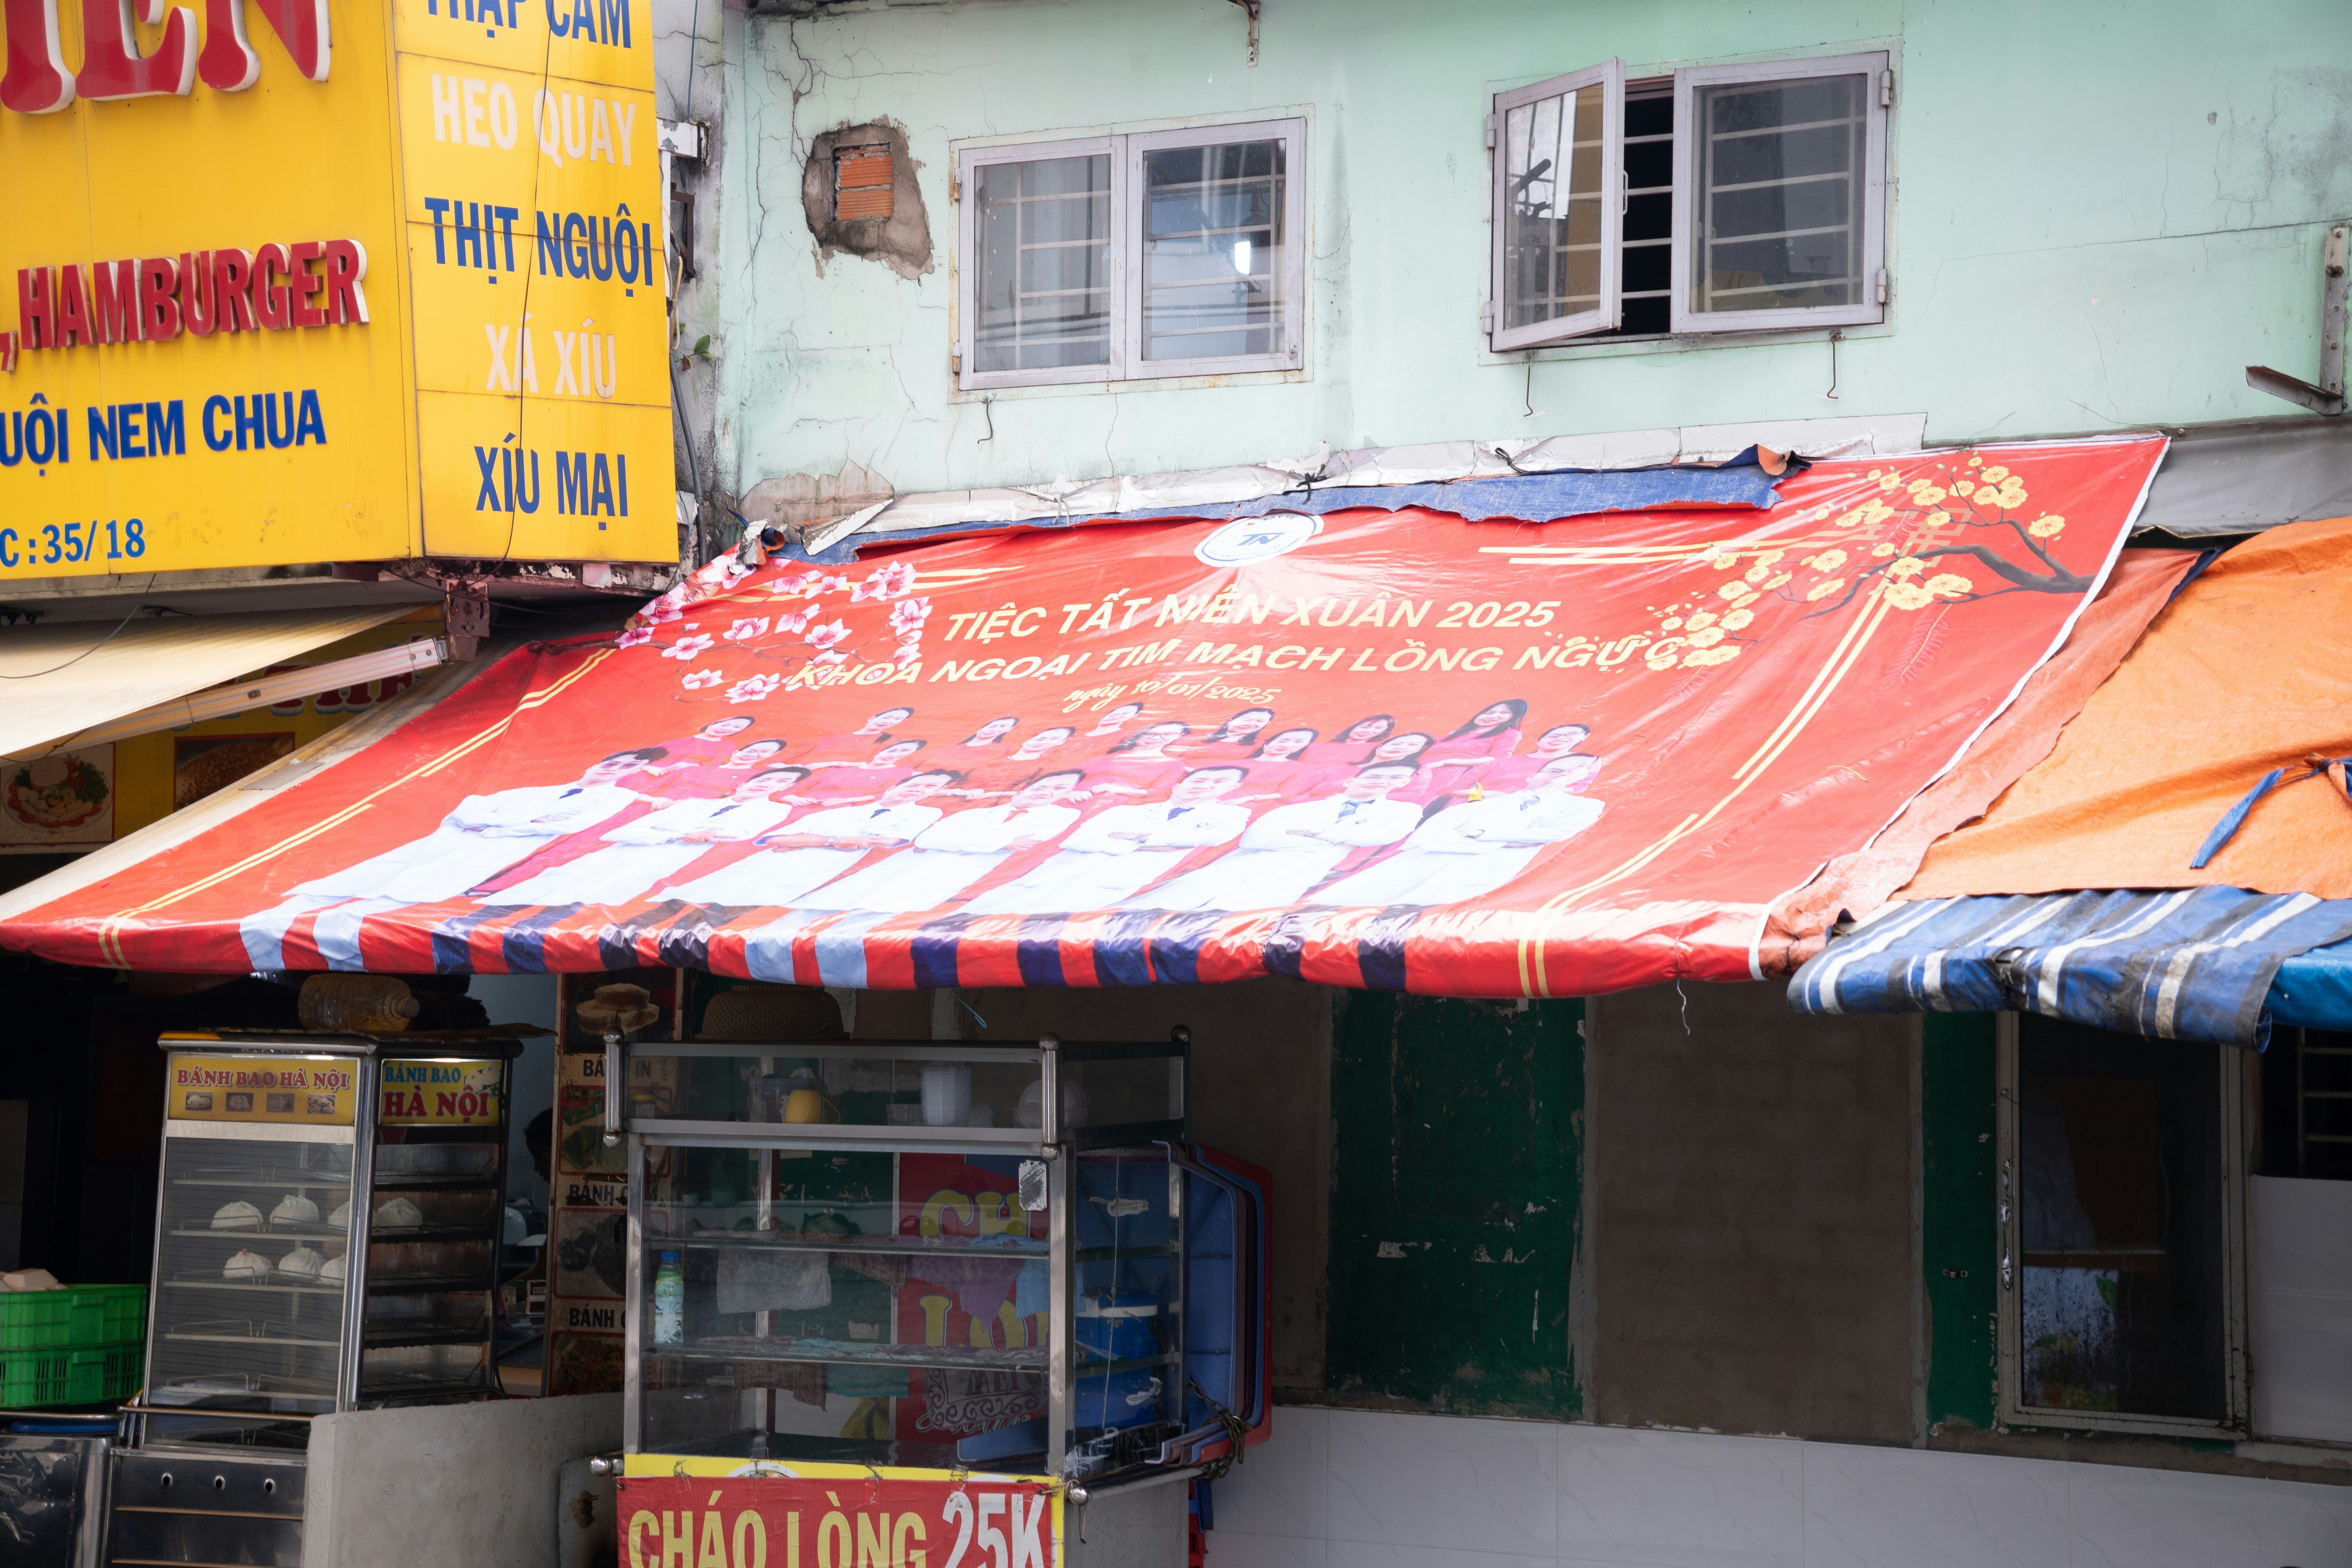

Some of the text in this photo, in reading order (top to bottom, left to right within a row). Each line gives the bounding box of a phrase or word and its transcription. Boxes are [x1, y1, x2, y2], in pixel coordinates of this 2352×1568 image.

[431, 73, 636, 169] HEO QUAY
[425, 197, 653, 298] THỊT NGUỘI
[485, 312, 617, 399] XÁ XÍU
[87, 399, 186, 461] NEM
[203, 389, 327, 452] CHUA
[474, 432, 628, 531] XÍU MẠI
[944, 584, 1561, 644] TIỆC TẤT NIÊN XUÂN 2025
[786, 637, 1686, 686] KHOA NGOẠI TIM MẠCH LỒNG NGỰC
[1062, 673, 1282, 713] ngày 10/01/2025
[176, 1065, 350, 1093] BÁNH BAO HÀ NỘI
[384, 1062, 461, 1083] BÁNH BAO
[635, 1060, 652, 1077] IN
[382, 1083, 490, 1124] HÀ NỘI
[569, 1303, 615, 1328] BÁNH
[628, 1490, 767, 1568] CHÁO
[942, 1491, 1046, 1568] 25K
